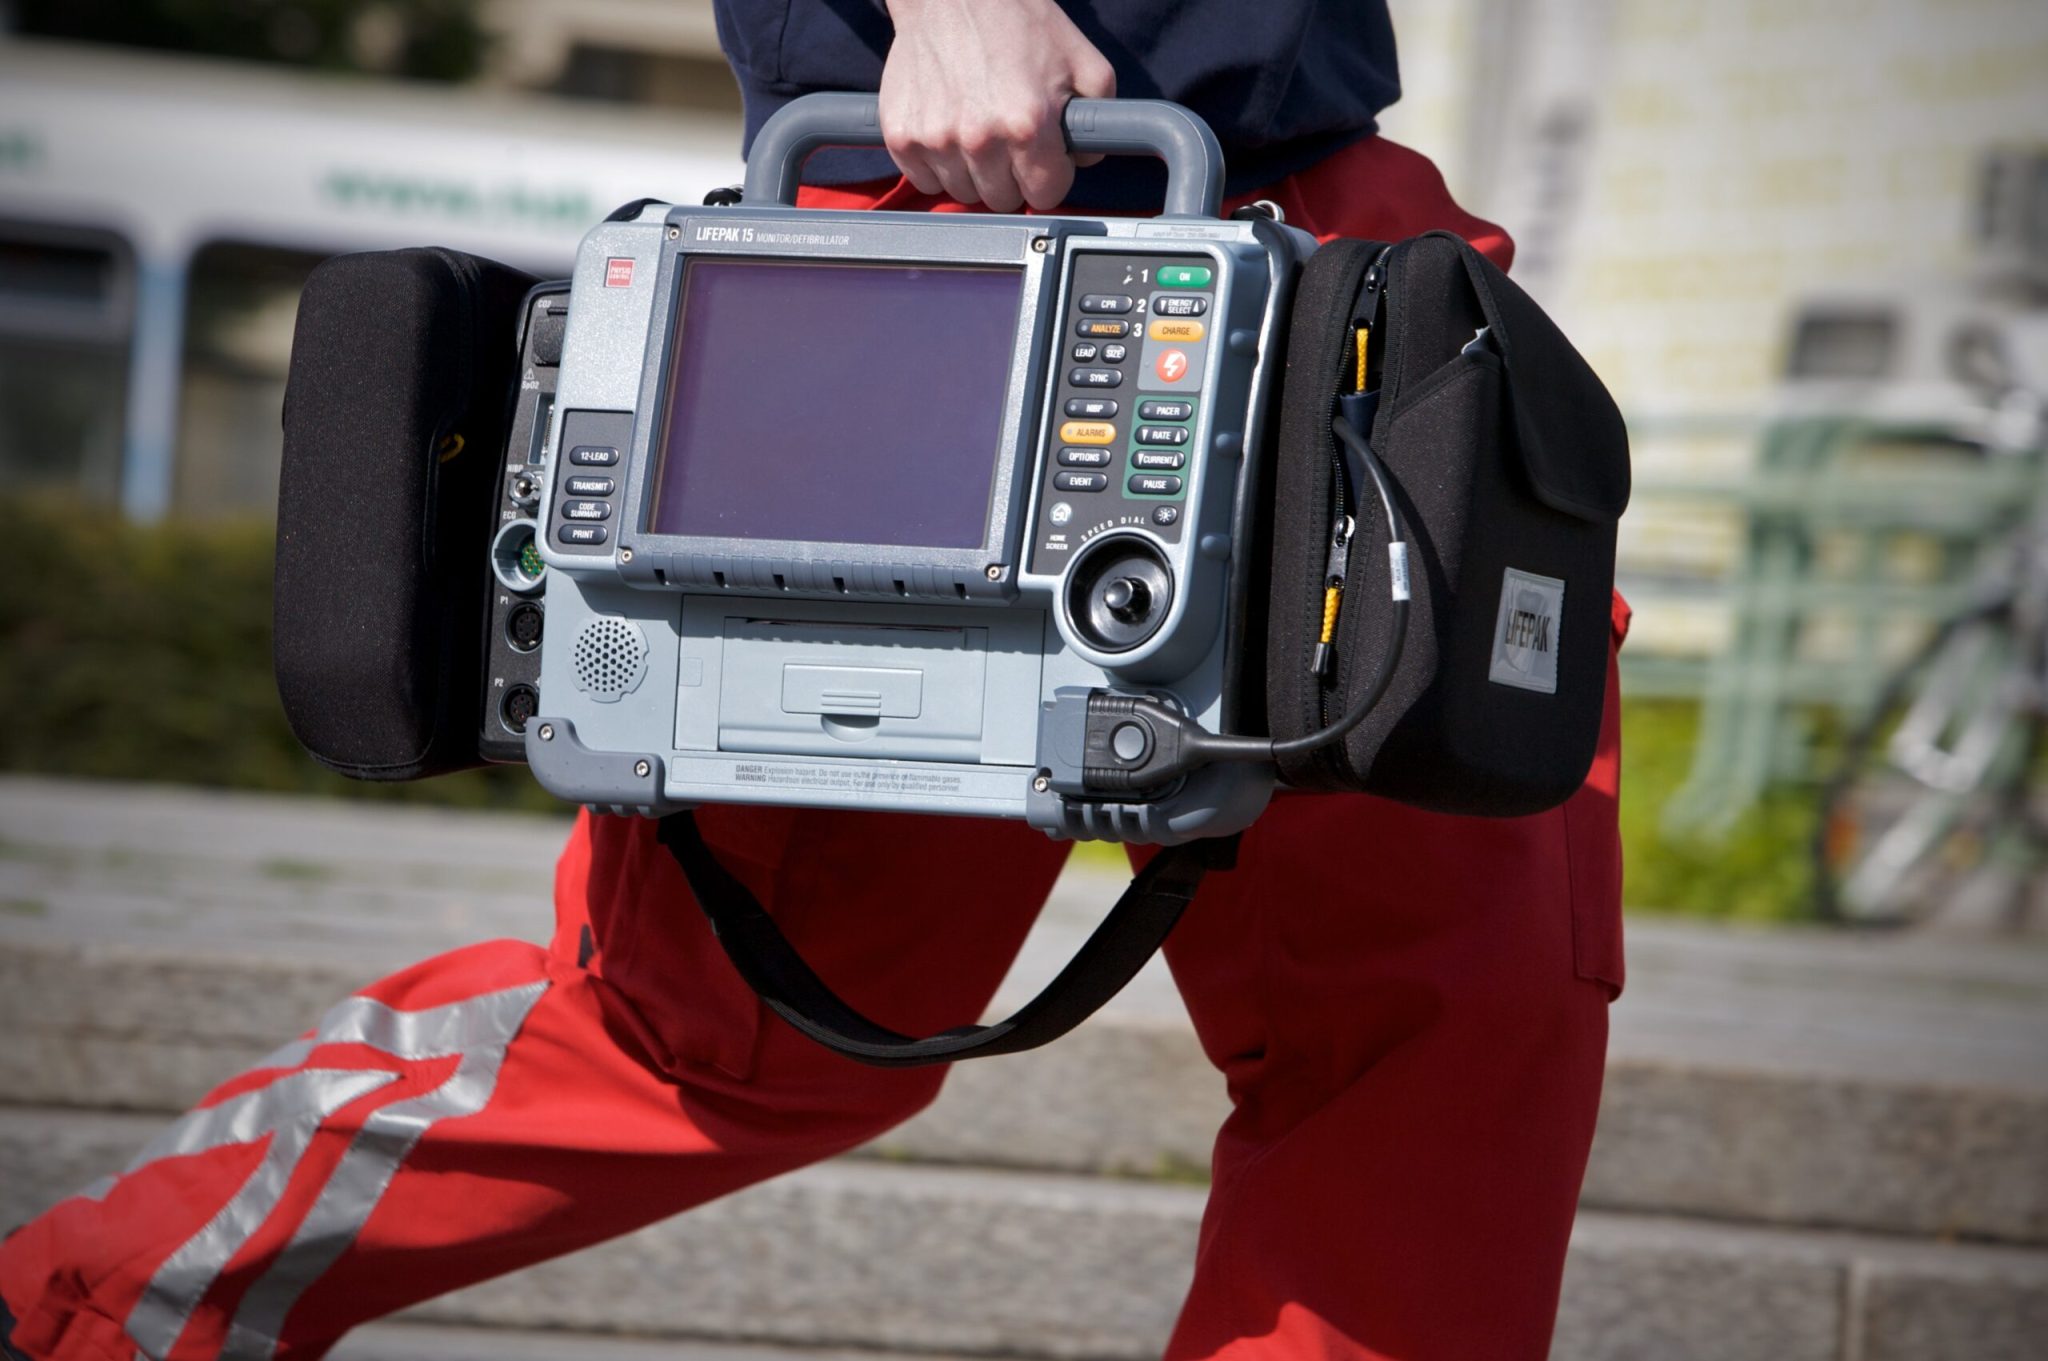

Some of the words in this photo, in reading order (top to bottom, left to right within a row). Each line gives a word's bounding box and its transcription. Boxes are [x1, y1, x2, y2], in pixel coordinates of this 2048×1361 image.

[696, 227, 740, 242] LIFEPAK
[742, 228, 754, 242] 15
[756, 232, 850, 246] MONITOR/DEFIBRILLATOR
[1141, 268, 1149, 283] 1
[1179, 272, 1191, 281] ON
[1100, 300, 1117, 309] CPR
[1136, 298, 1147, 313] 2
[1167, 306, 1192, 314] SELECT
[1090, 323, 1121, 334] ANALYZE
[1133, 323, 1143, 338] 3
[1162, 326, 1190, 336] CHARGE
[1075, 348, 1094, 358] LEAD
[1105, 349, 1122, 358] SIZE
[1089, 373, 1108, 383] SYNC
[1156, 406, 1180, 416] PACER
[1076, 427, 1106, 438] ALARMS
[1152, 430, 1171, 440] RATE
[580, 451, 609, 461] 12-LEAD
[1068, 452, 1099, 462] OPTIONS
[1143, 454, 1174, 464] CURRENT
[572, 480, 608, 491] TRANSMIT
[1069, 477, 1093, 486] EVENT
[1143, 479, 1167, 489] PAUSE
[578, 502, 596, 510] CODE
[502, 511, 517, 519] ECG
[570, 509, 602, 518] SUMMARY
[572, 529, 594, 539] PRINT
[1080, 519, 1114, 542] SPEED
[1120, 516, 1146, 525] DIAL
[1049, 534, 1067, 542] HOME
[1045, 542, 1069, 550] SCREEN
[500, 596, 509, 605] P1
[1504, 607, 1551, 653] LIFEPAK
[494, 678, 504, 687] P2
[736, 765, 763, 774] DANGER
[736, 773, 767, 782] WARNING
